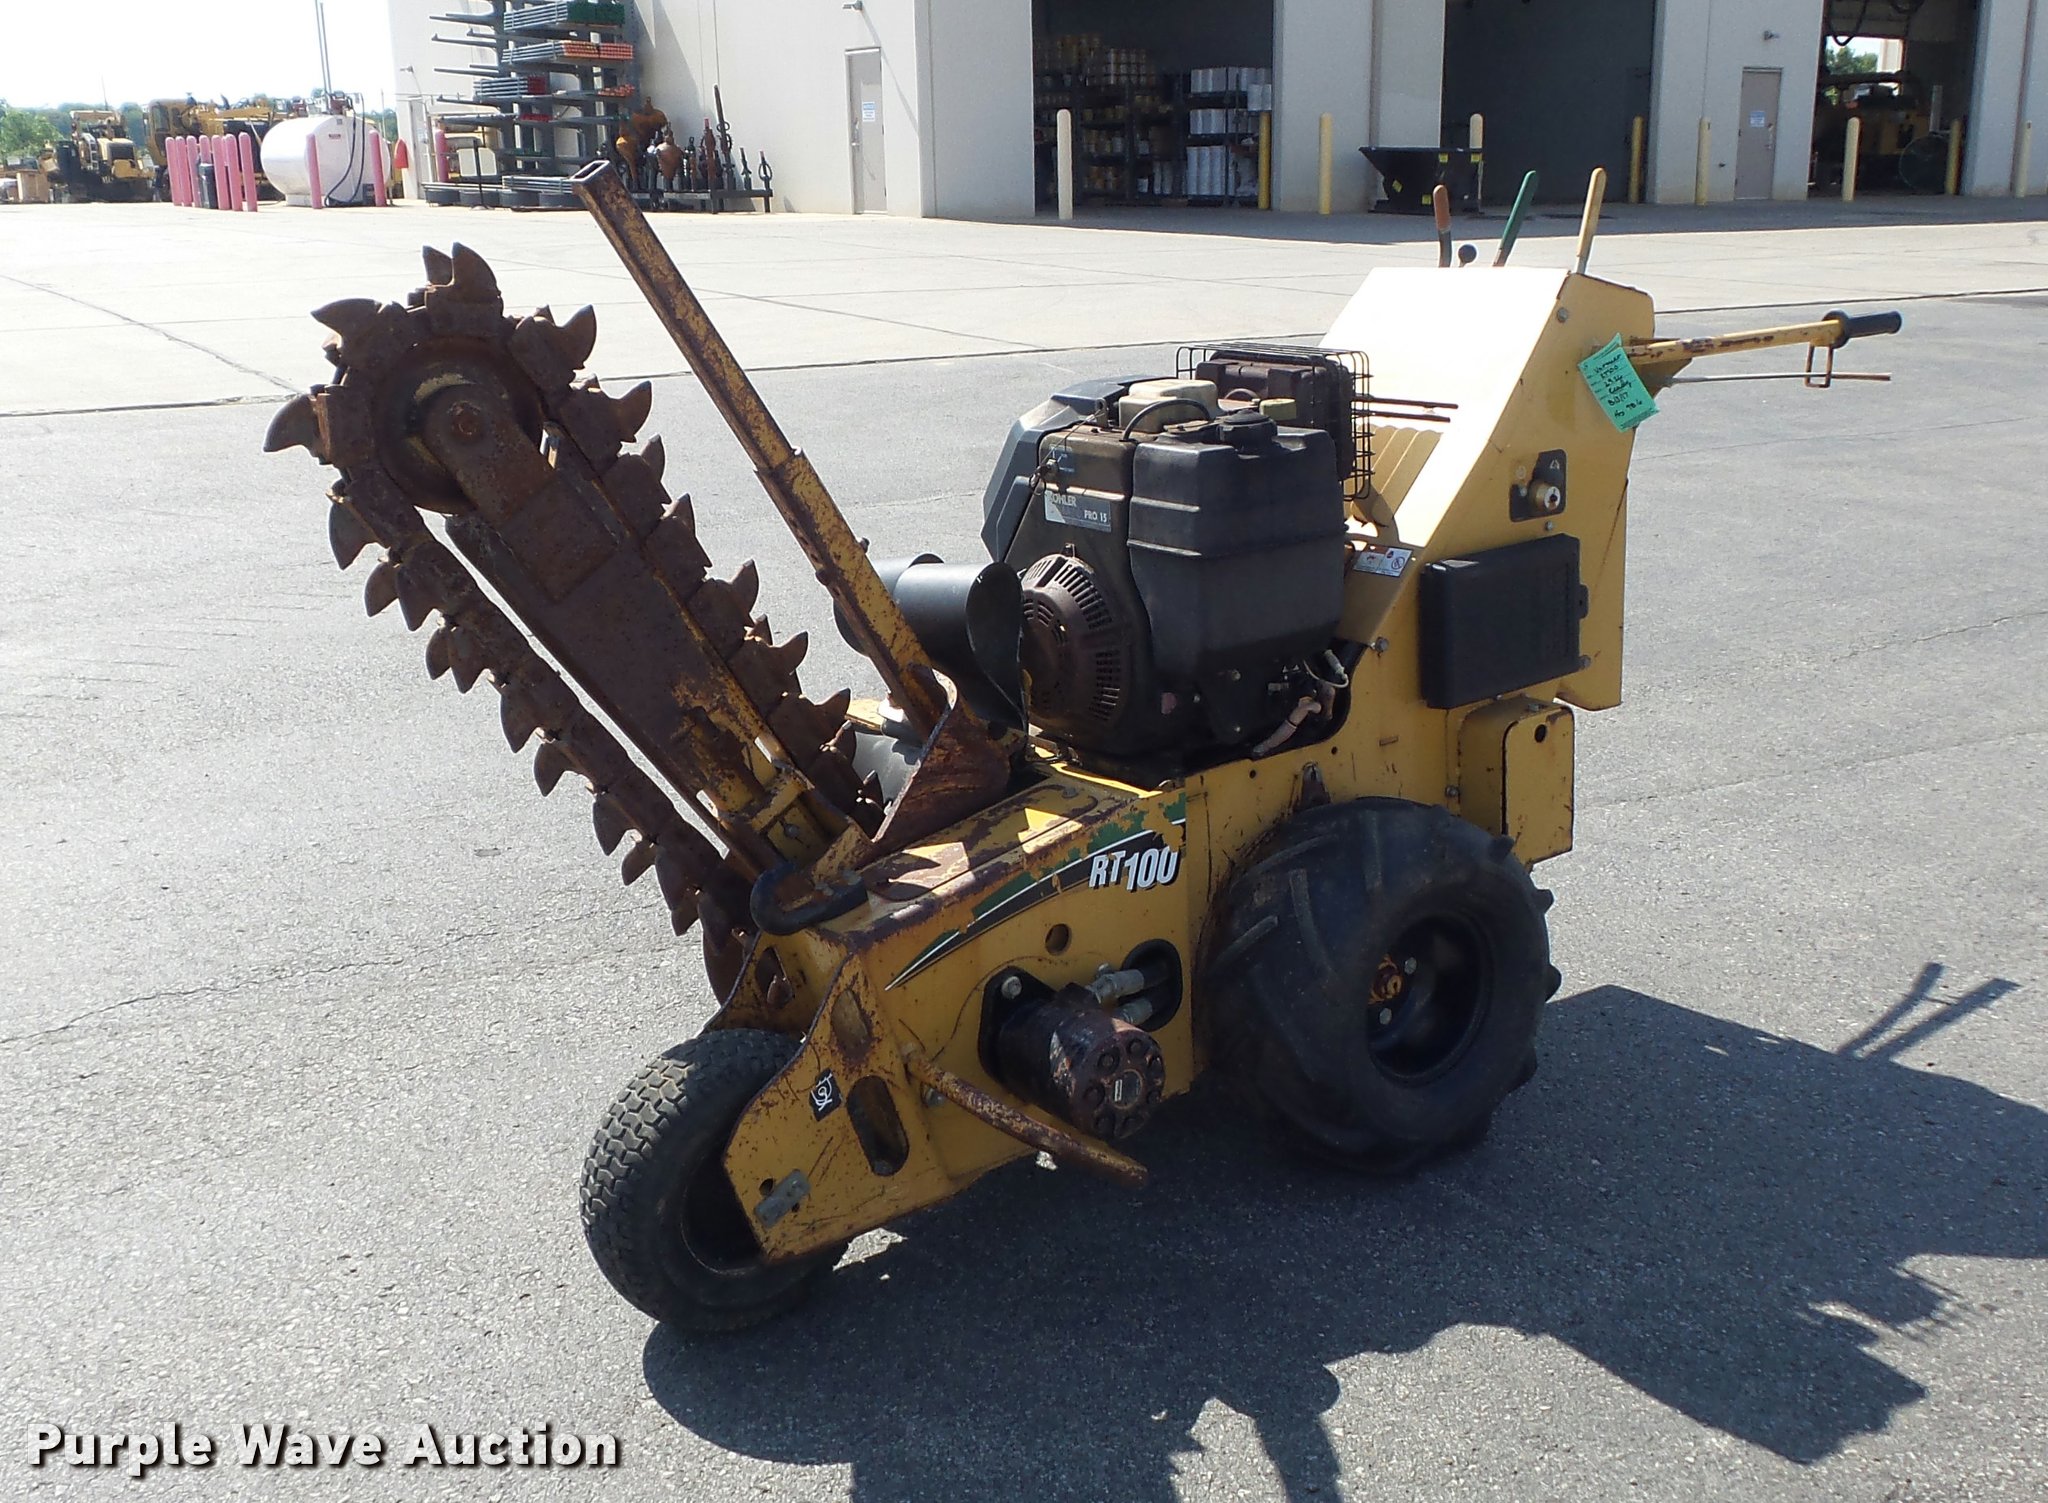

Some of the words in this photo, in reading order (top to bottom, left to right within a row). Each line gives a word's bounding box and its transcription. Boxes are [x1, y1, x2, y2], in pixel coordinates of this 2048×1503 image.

[1084, 510, 1098, 520] PRO
[1100, 512, 1107, 523] 15
[1088, 846, 1179, 892] RT100
